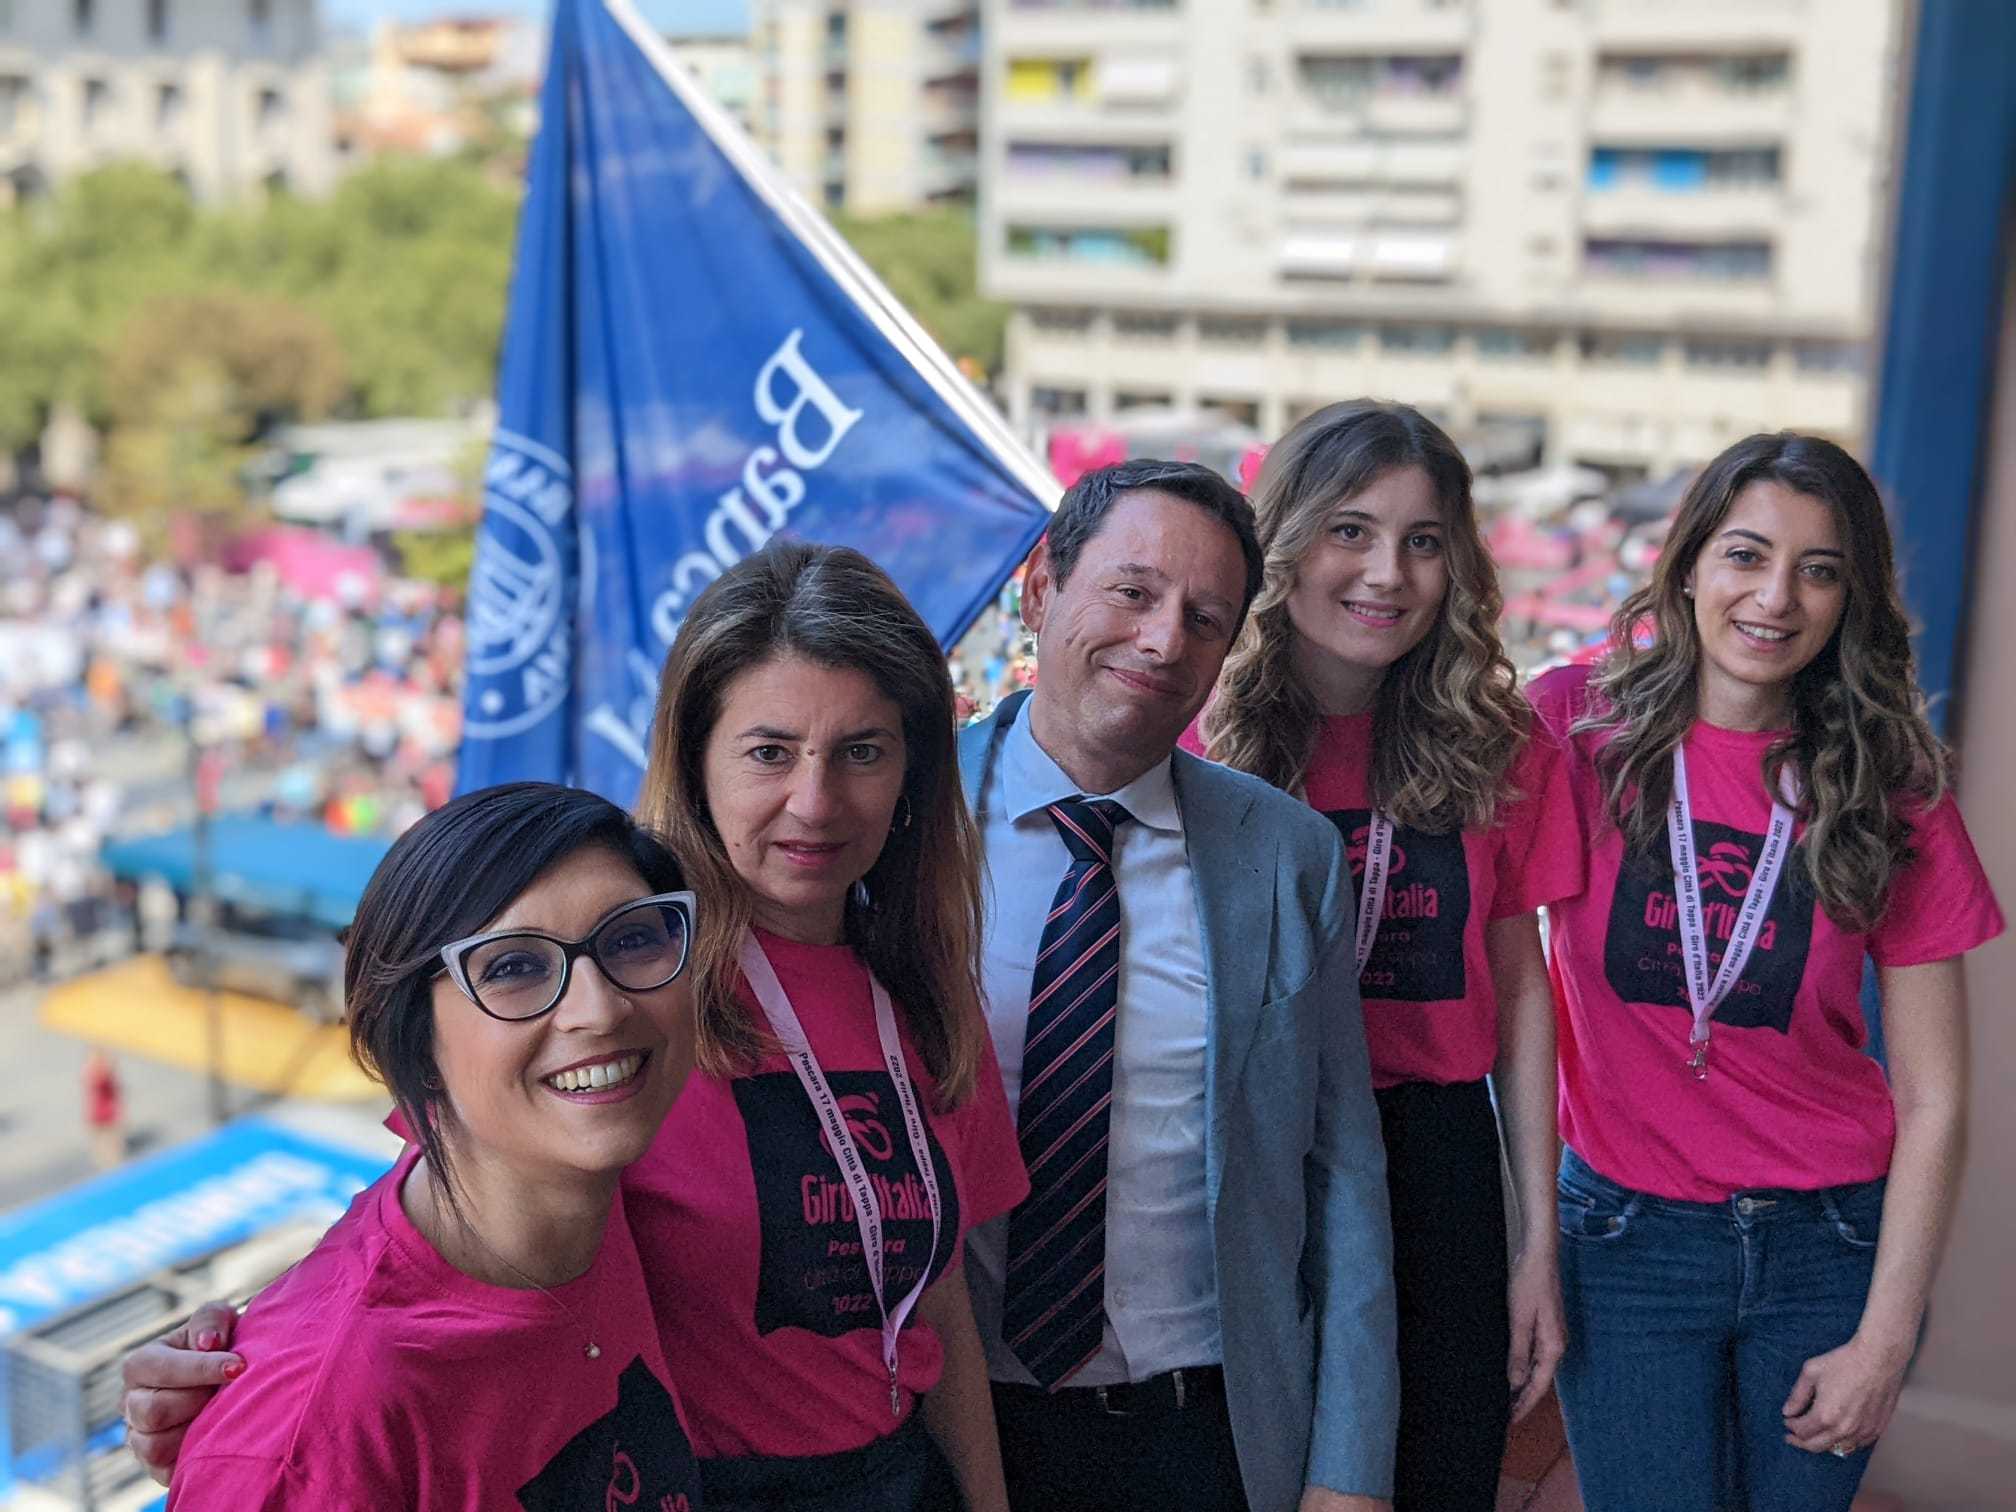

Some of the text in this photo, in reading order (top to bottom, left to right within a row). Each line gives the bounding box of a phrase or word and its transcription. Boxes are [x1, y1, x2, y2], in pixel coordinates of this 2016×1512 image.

[1674, 800, 1685, 831] Pescara
[1677, 833, 1687, 842] 17
[1687, 904, 1697, 928] Tappa
[1690, 935, 1700, 952] Giro
[799, 1052, 823, 1092] Pescara
[820, 1093, 832, 1106] 17
[825, 1108, 846, 1146] maggio
[842, 1147, 858, 1171] Città
[853, 1174, 864, 1184] di
[858, 1184, 873, 1217] Tappa
[869, 1225, 878, 1248] Giro
